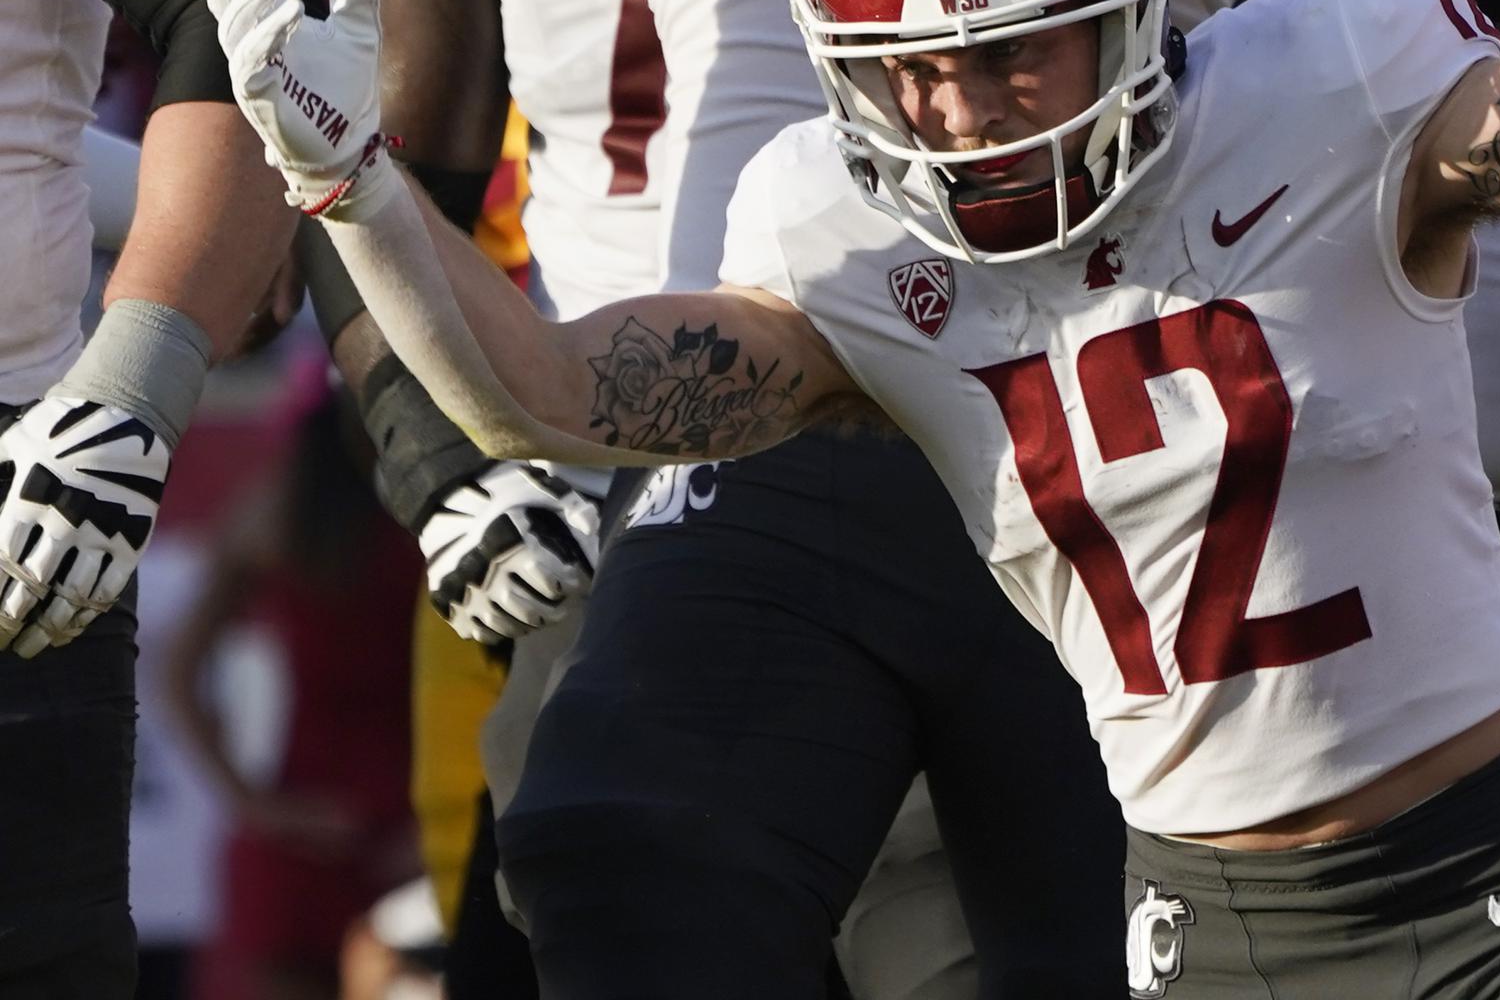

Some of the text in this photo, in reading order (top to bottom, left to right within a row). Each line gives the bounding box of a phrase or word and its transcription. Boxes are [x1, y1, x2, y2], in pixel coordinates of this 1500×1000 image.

[889, 261, 951, 312] PAC
[910, 291, 944, 324] 12
[962, 299, 1373, 696] 12
